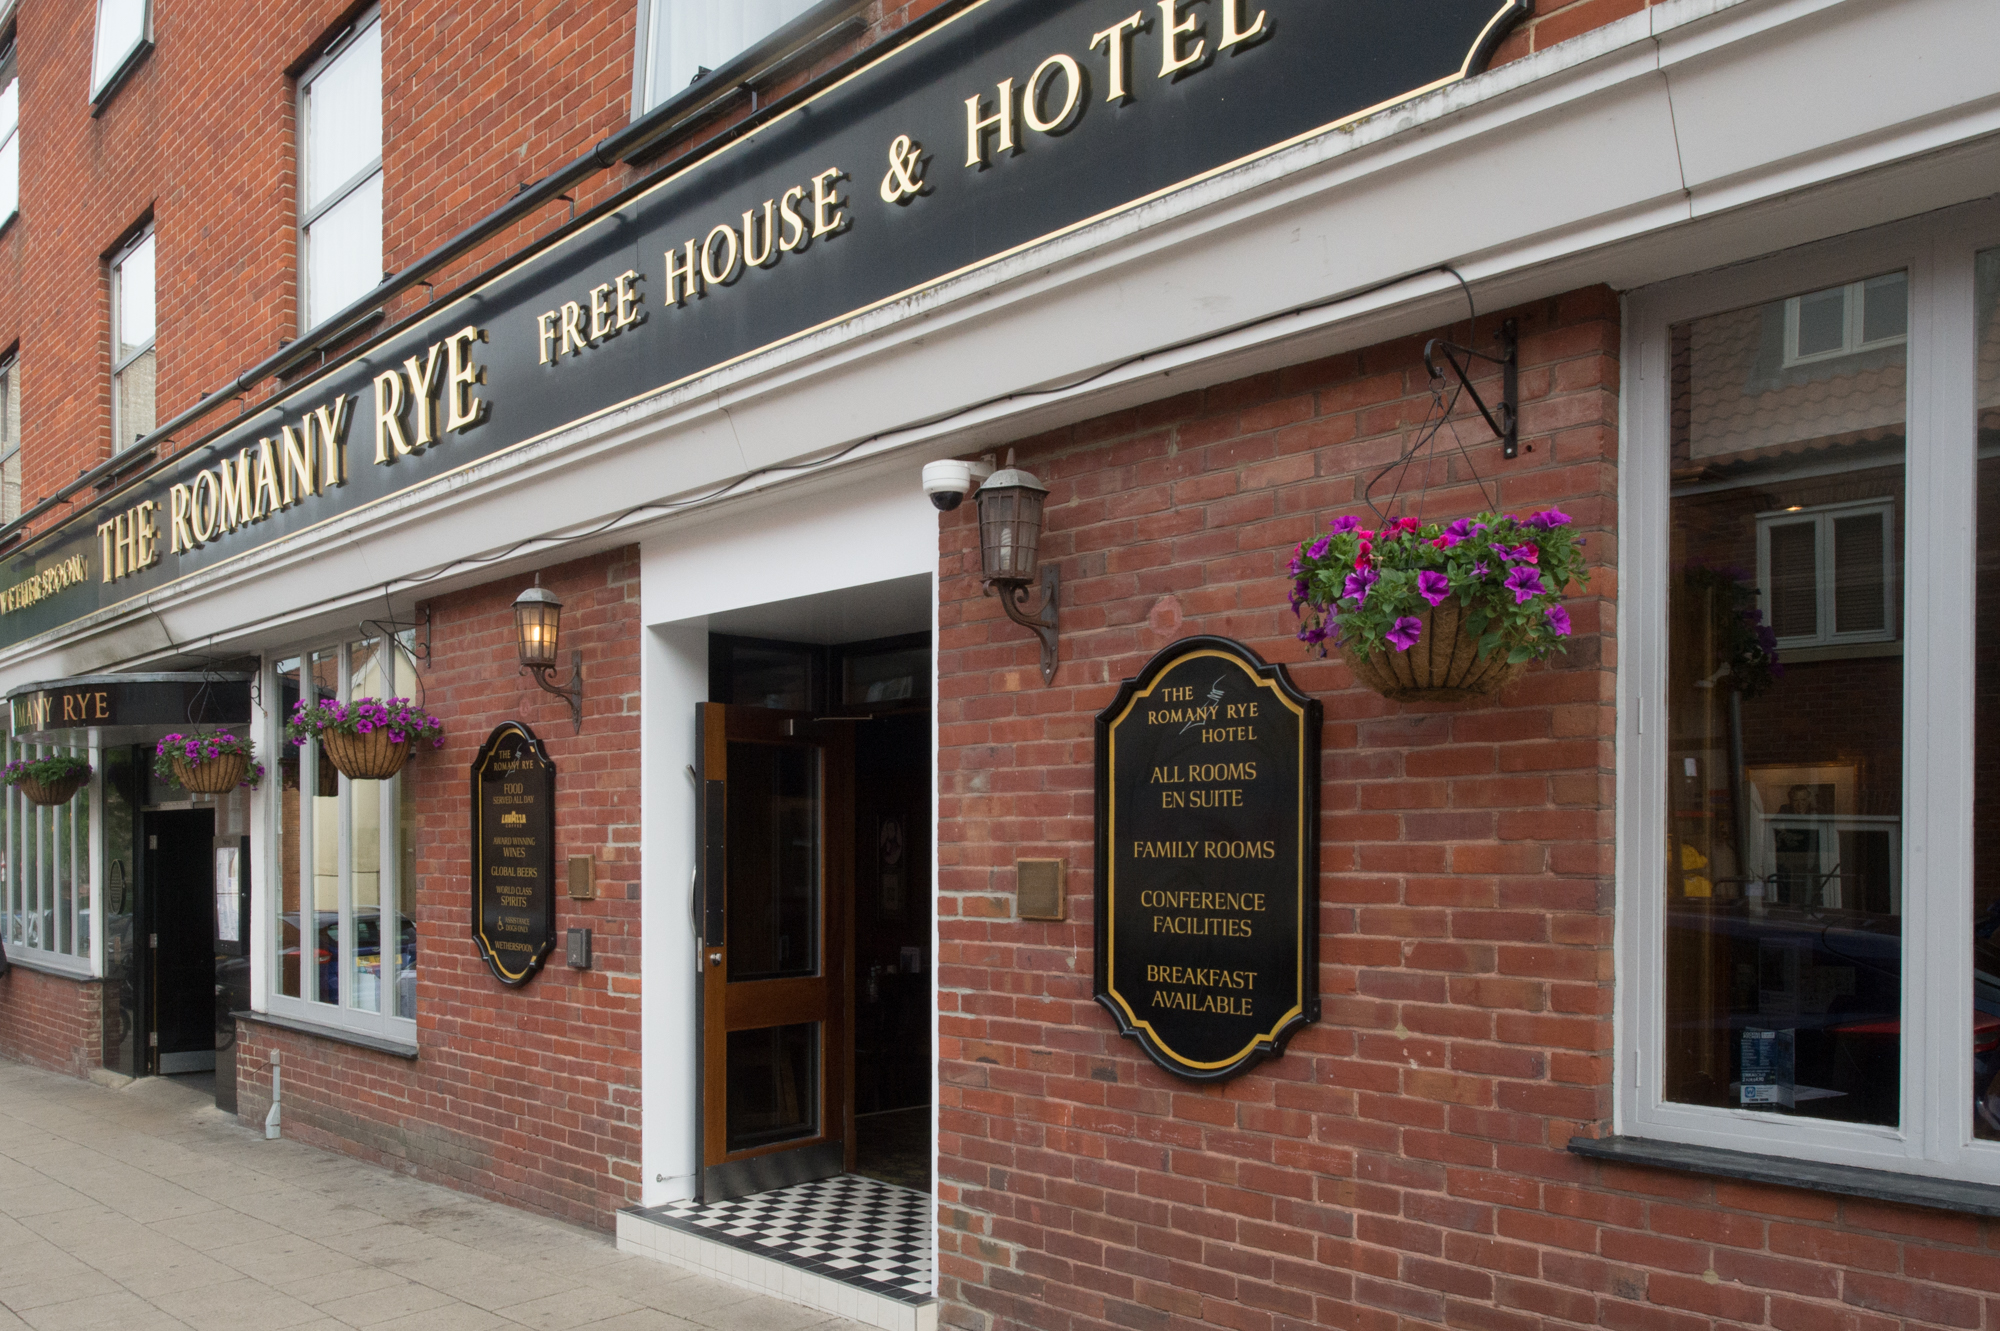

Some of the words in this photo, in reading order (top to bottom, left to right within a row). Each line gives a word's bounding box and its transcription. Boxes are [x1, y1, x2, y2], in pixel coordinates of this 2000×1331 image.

[97, 500, 160, 584] THE
[169, 394, 348, 554] ROMANY
[373, 325, 485, 465] RYE
[537, 269, 640, 365] FREE
[663, 166, 844, 307] HOUSE
[880, 135, 924, 203] &
[964, 0, 1266, 168] HOTEL
[1161, 686, 1194, 702] THE
[63, 692, 110, 721] RYE
[1148, 706, 1219, 725] ROMANY
[1226, 702, 1259, 719] RYE
[1202, 726, 1258, 743] HOTEL
[498, 750, 511, 759] THE
[493, 761, 520, 771] ROMANY
[521, 760, 534, 770] RYE
[1150, 766, 1185, 784] ALL
[1188, 761, 1257, 782] ROOMS
[503, 783, 524, 794] FOOD
[492, 796, 513, 804] SERVED
[513, 796, 523, 804] ALL
[523, 795, 534, 803] DAY
[1161, 791, 1185, 808] EN
[1189, 789, 1244, 808] SUITE
[492, 837, 512, 845] AWARD
[512, 837, 536, 846] WINNING
[1133, 841, 1199, 858] FAMILY
[1204, 840, 1275, 859] ROOMS
[503, 847, 526, 858] WINES
[491, 866, 516, 877] GLOBAL
[517, 867, 538, 878] BEERS
[496, 886, 515, 895] WORLD
[516, 887, 533, 896] CLASS
[501, 896, 527, 908] SPIRITS
[1141, 890, 1266, 911] CONFERENCE
[1153, 916, 1252, 937] FACILITIES
[494, 940, 533, 953] WETHERSPOON
[1147, 965, 1257, 990] BREAKFAST
[1152, 990, 1253, 1016] AVAILABLE
